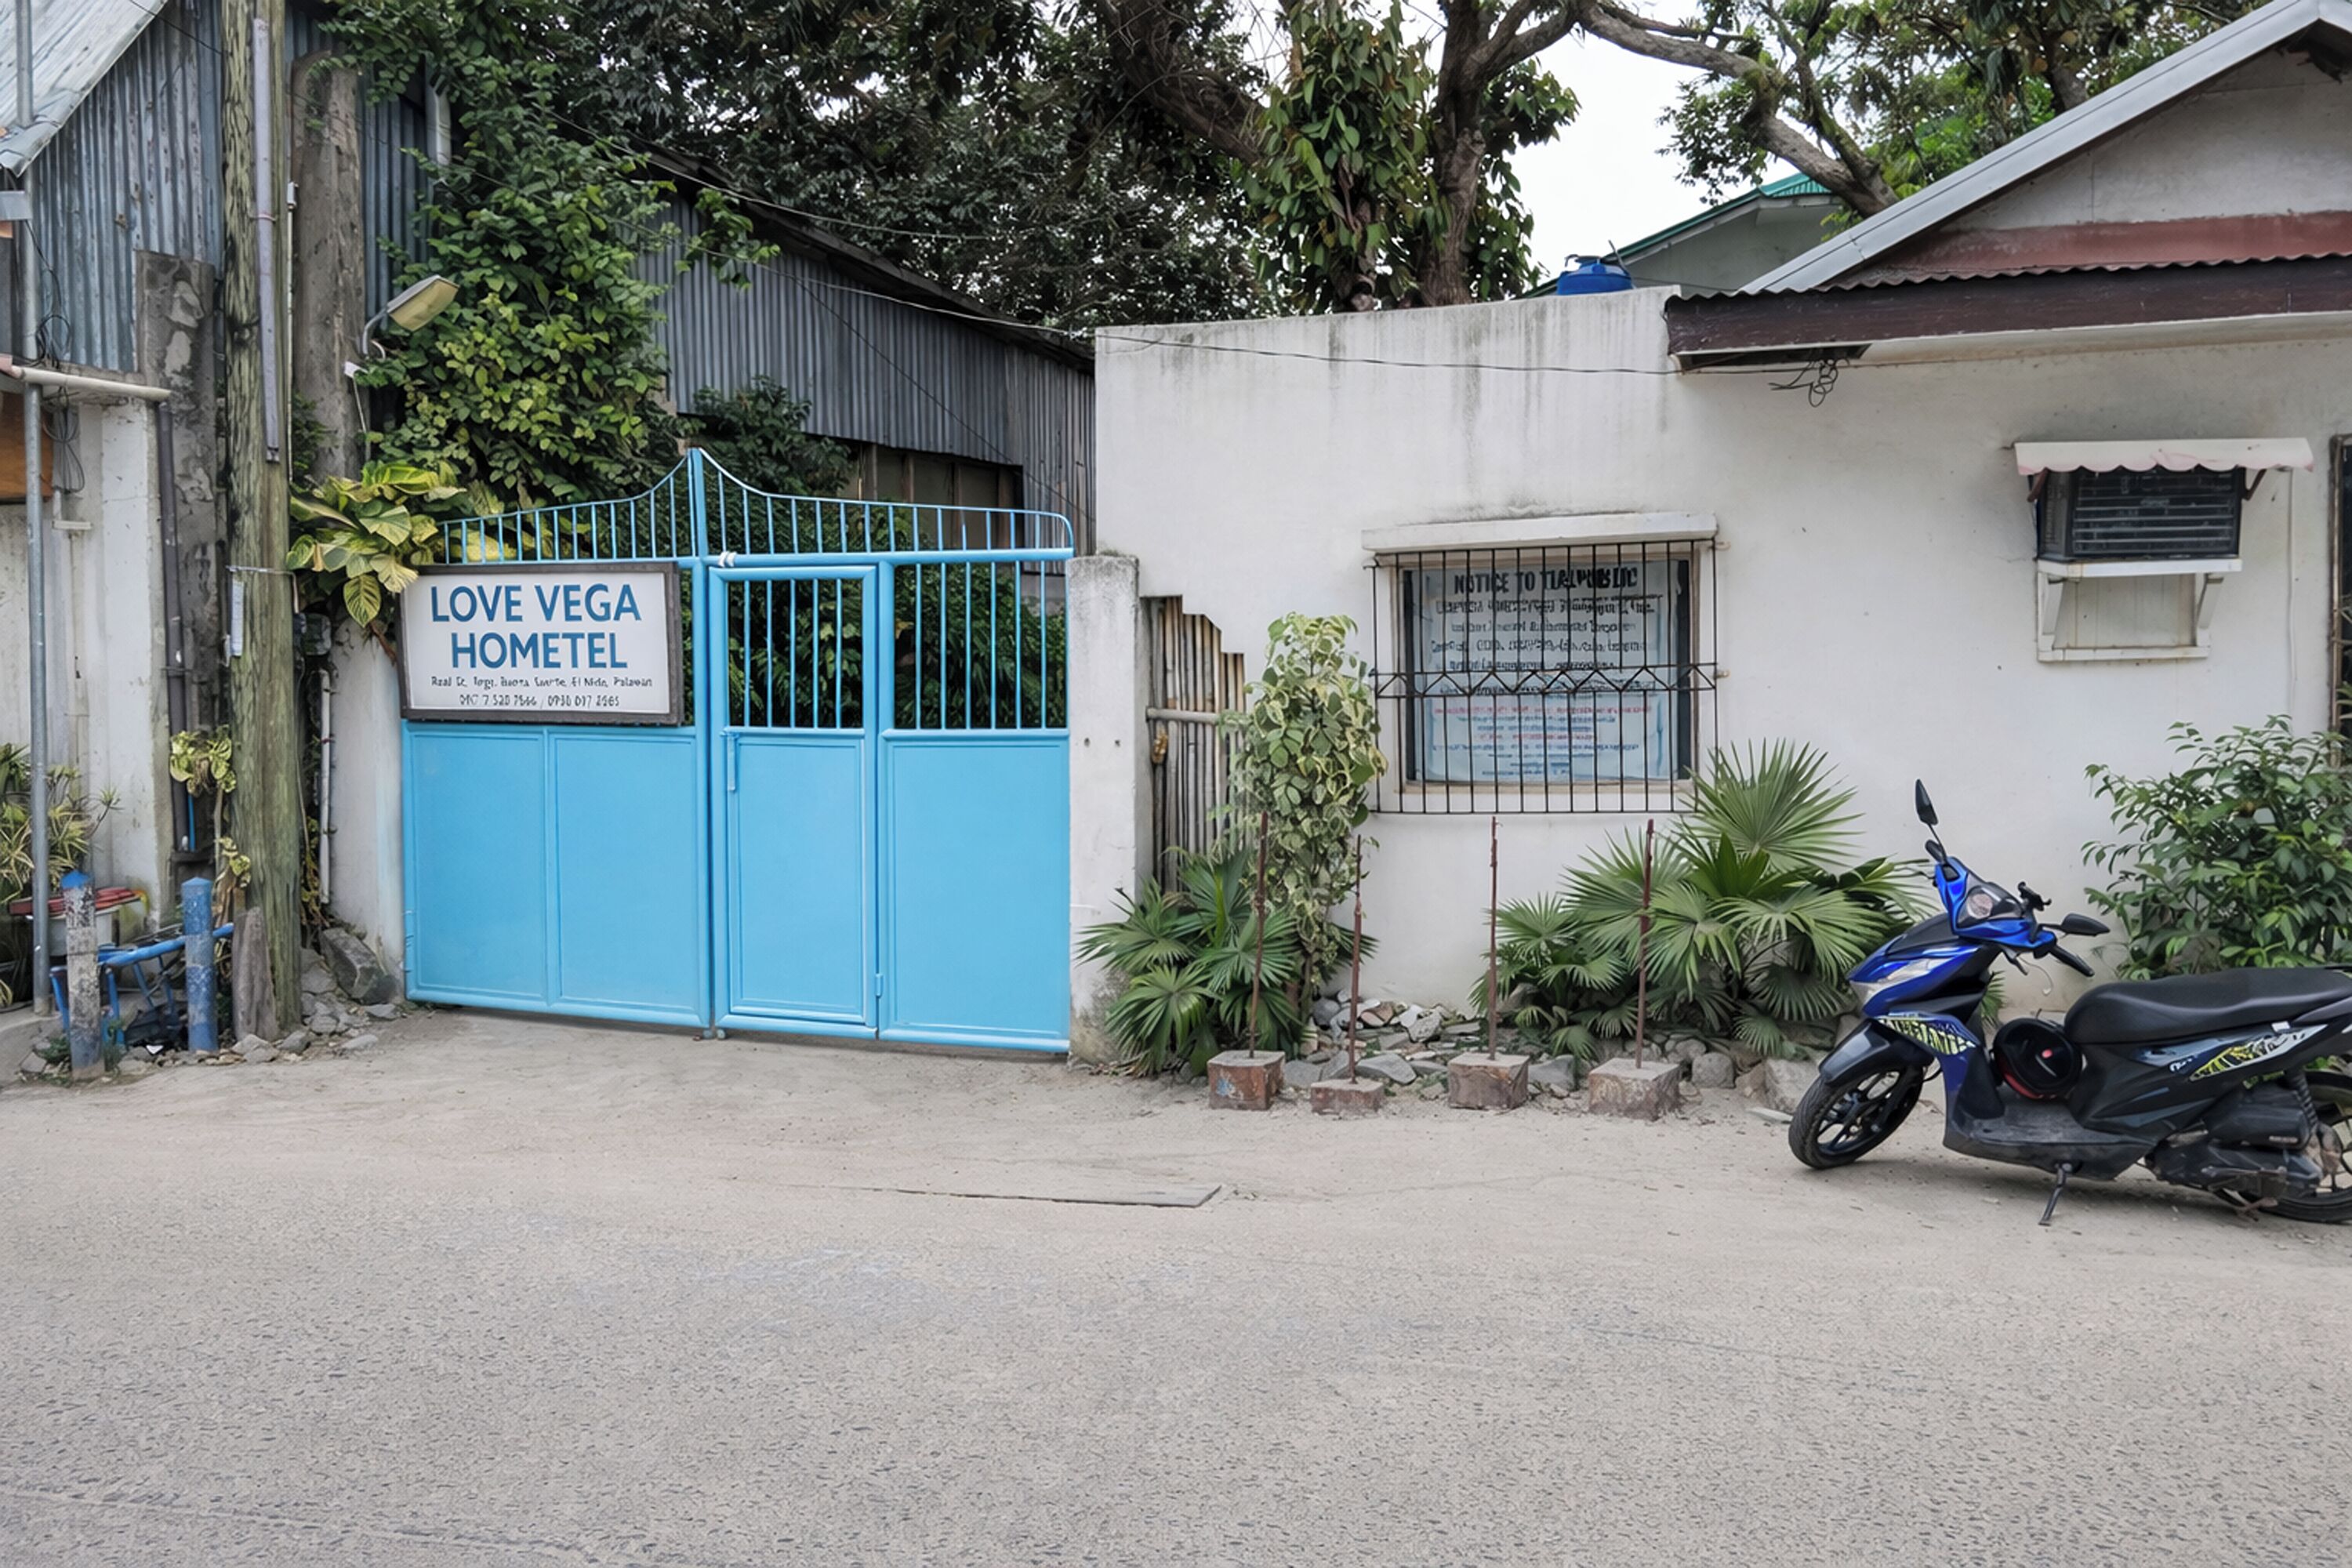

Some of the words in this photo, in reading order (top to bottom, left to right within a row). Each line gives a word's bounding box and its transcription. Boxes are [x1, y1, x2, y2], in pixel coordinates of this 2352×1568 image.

[430, 584, 523, 623] LOVE
[534, 583, 642, 622] VEGA
[451, 632, 629, 669] HOMETEL
